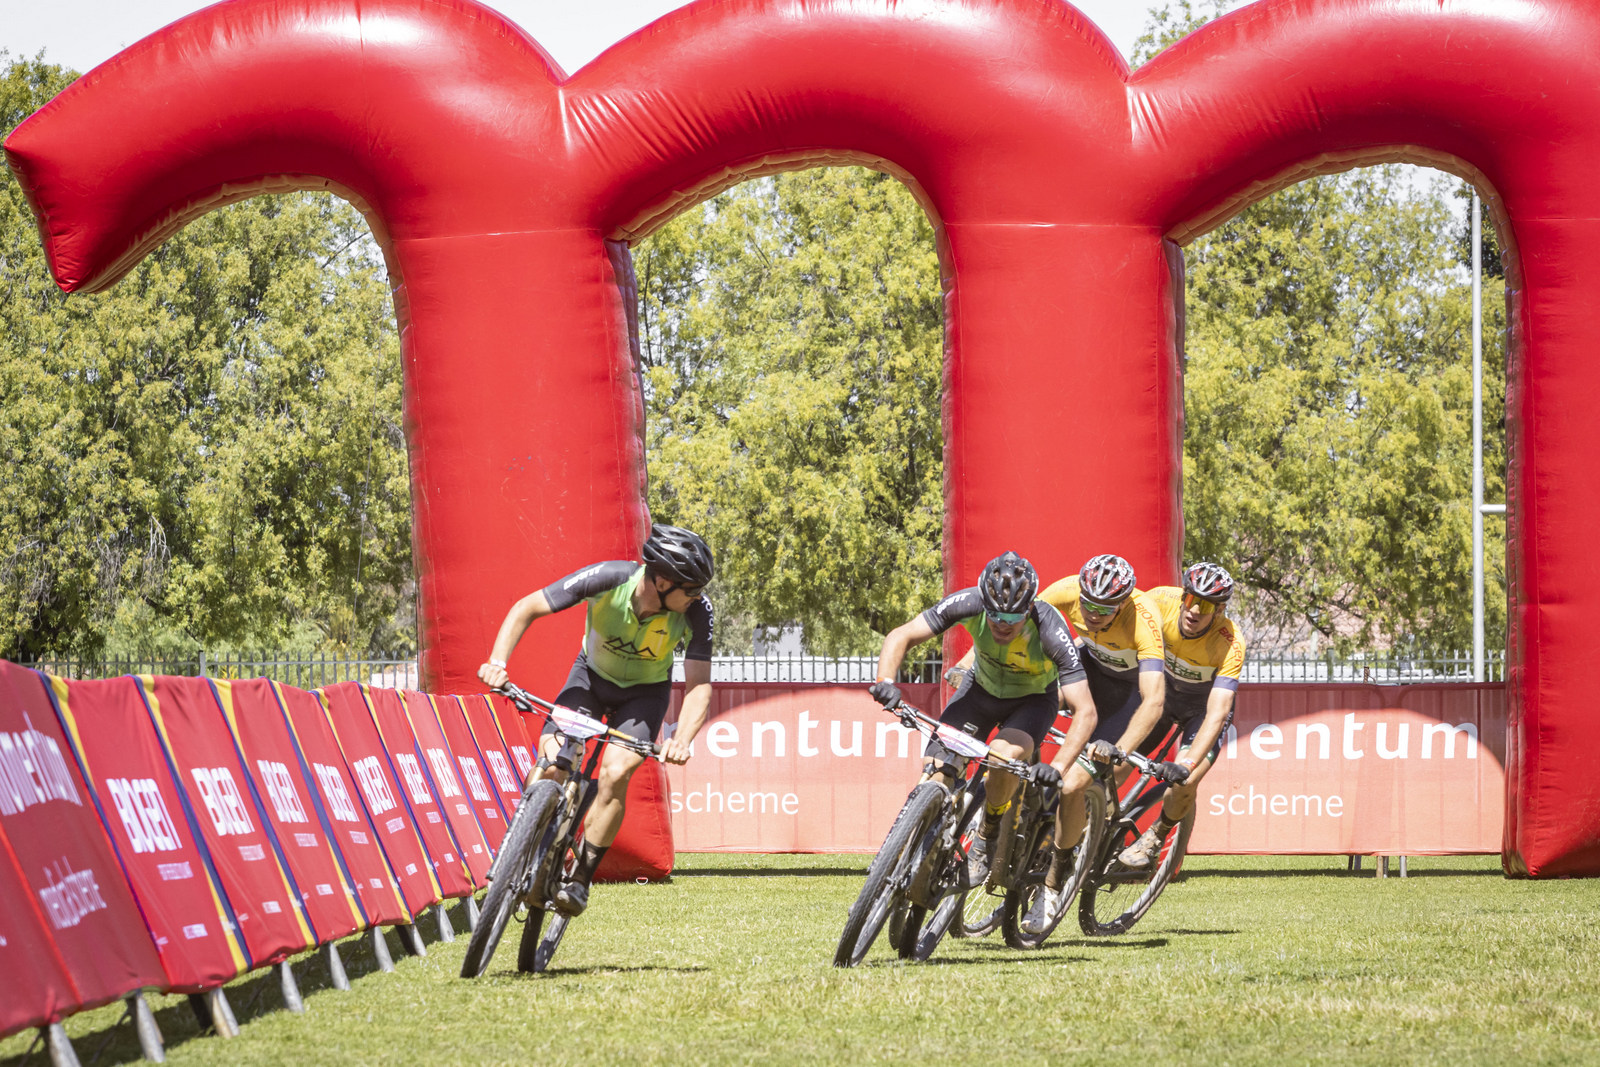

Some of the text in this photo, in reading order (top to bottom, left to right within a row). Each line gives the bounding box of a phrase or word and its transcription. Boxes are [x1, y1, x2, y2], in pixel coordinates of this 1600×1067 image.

[0, 710, 84, 817] omentum
[671, 782, 799, 815] scheme
[1208, 784, 1343, 817] scheme
